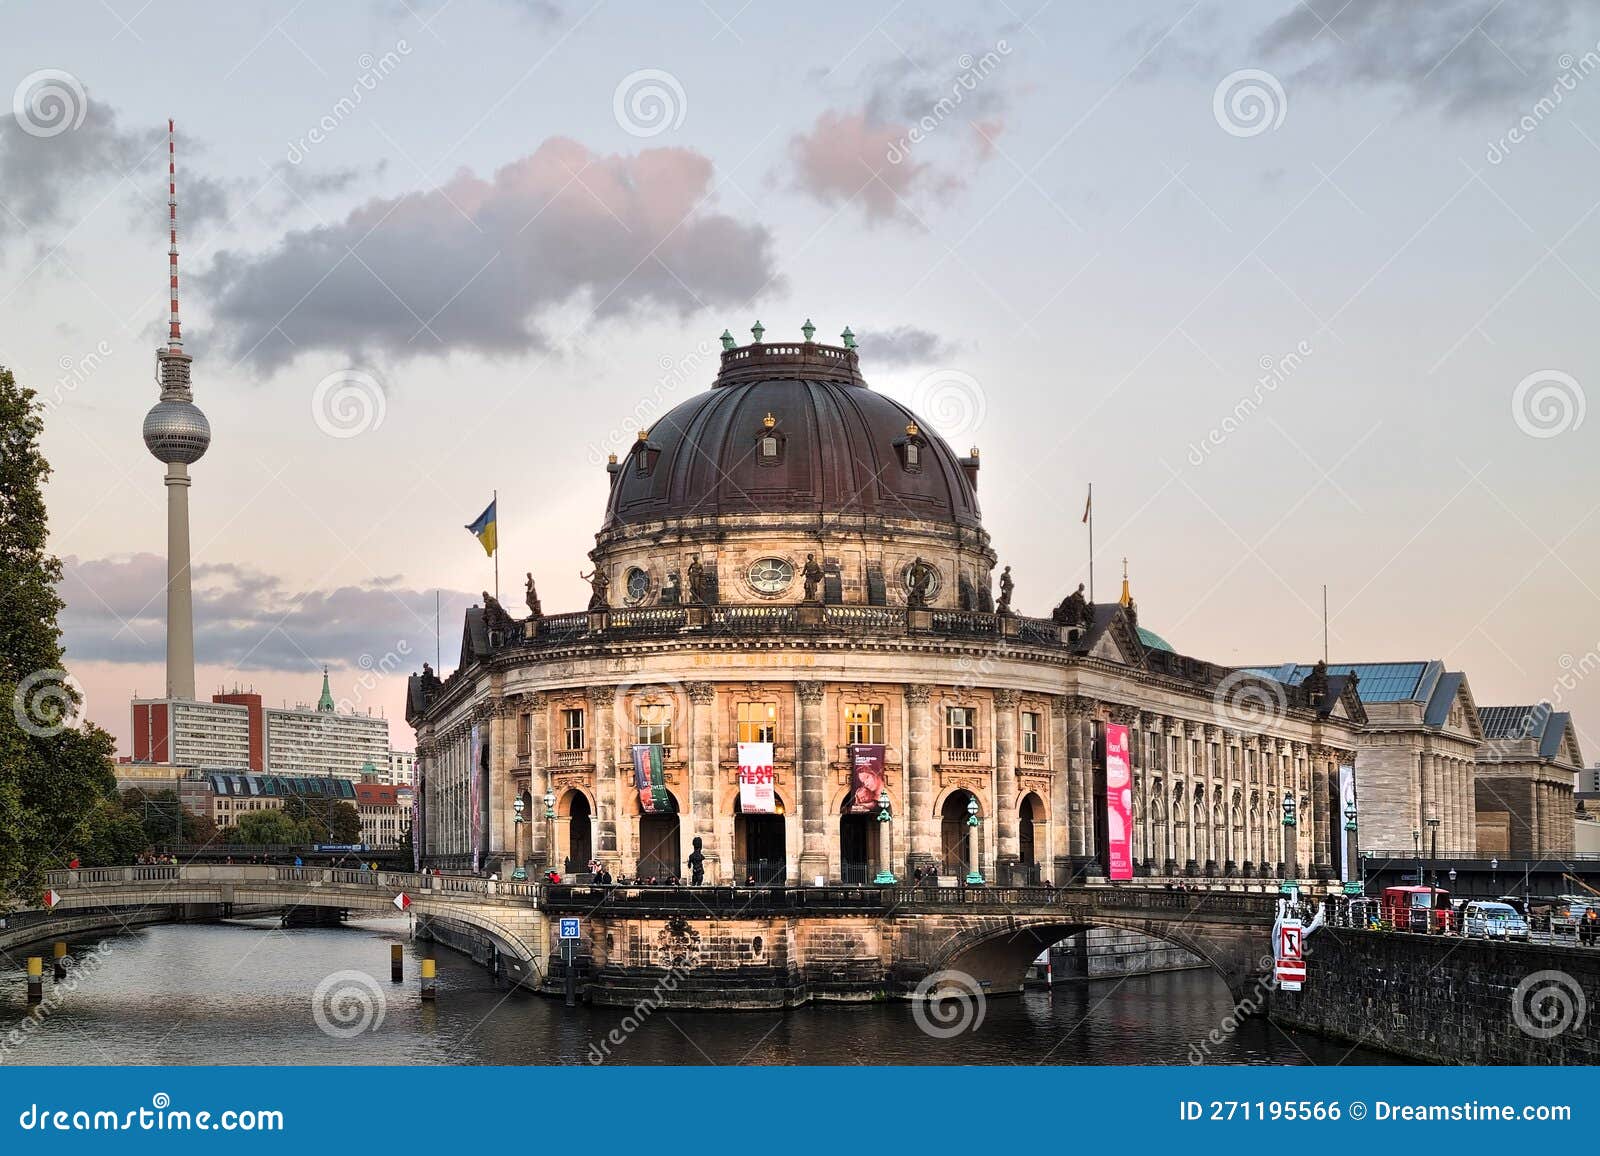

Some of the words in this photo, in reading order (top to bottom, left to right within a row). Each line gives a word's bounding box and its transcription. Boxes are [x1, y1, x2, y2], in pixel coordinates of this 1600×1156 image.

[738, 765, 773, 776] KLAR
[740, 774, 773, 785] TEXT
[564, 926, 576, 936] 20
